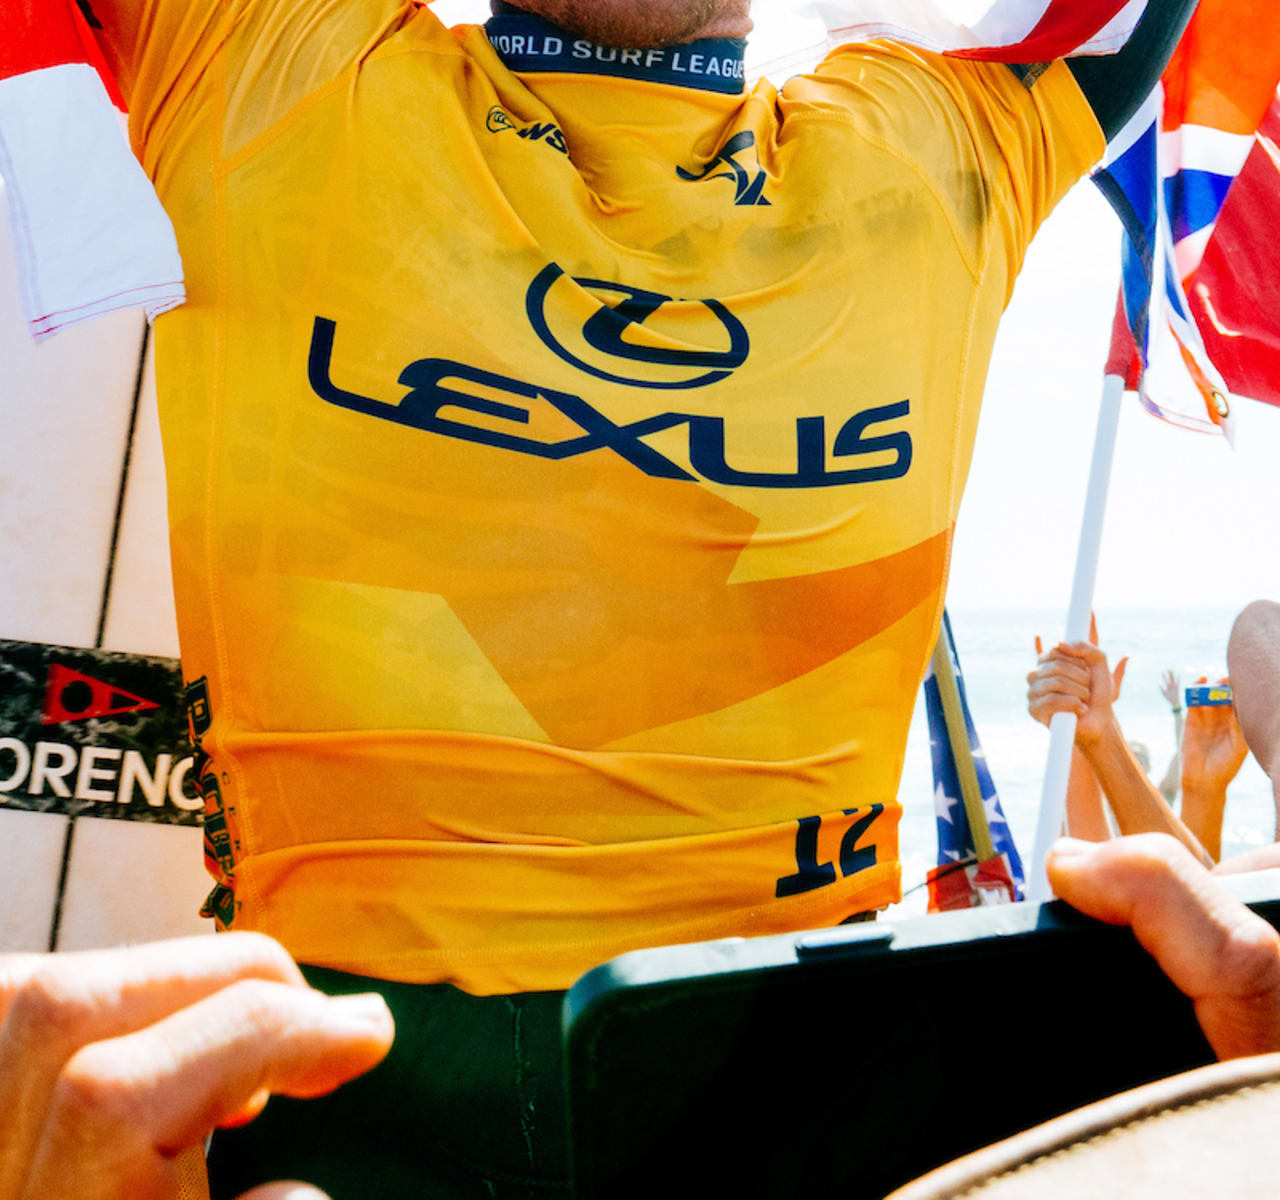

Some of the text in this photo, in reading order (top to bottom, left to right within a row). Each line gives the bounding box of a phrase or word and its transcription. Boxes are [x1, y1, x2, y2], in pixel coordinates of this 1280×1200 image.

[572, 40, 664, 68] SURF
[516, 122, 570, 157] WS
[306, 315, 913, 489] LEXUS
